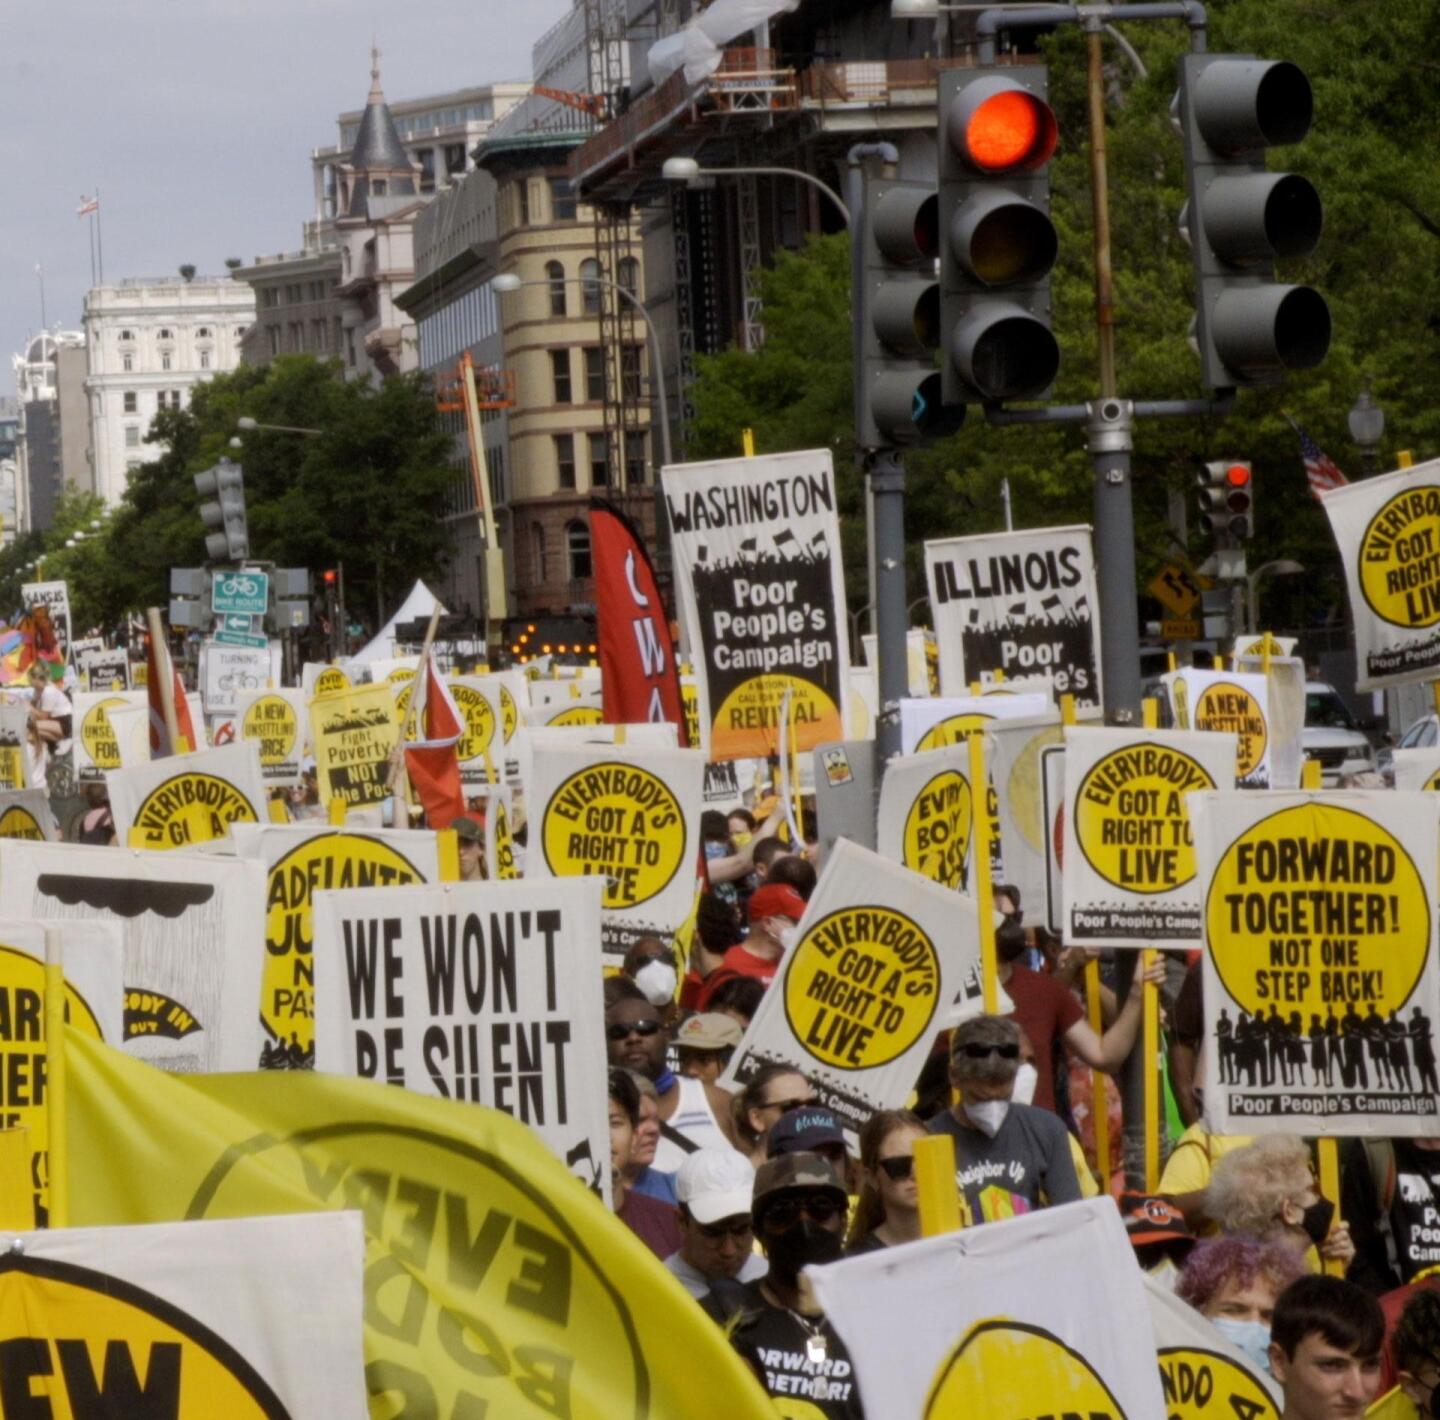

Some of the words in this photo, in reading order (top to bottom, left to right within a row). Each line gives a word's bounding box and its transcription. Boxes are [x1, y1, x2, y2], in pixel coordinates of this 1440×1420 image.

[665, 472, 833, 534] WASHINGTON
[1367, 491, 1440, 562] EVERYBO
[1396, 528, 1433, 563] GOT
[934, 547, 1081, 603] ILLINOIS
[734, 578, 797, 607] Poor
[713, 604, 826, 639] People's
[220, 653, 258, 664] TURNING
[713, 640, 832, 671] Campaign
[1002, 640, 1064, 667] Poor
[1370, 655, 1401, 669] Poor
[255, 704, 263, 720] A
[265, 703, 286, 720] NEW
[1205, 695, 1215, 715] A
[1219, 695, 1248, 715] NEW
[246, 722, 294, 737] UNSETTLING
[341, 729, 371, 745] Fight
[329, 739, 391, 763] Poverty
[347, 762, 378, 783] NOT
[142, 780, 247, 842] EVERYBODY'S
[555, 768, 676, 830] EVERYBODY'S
[1118, 791, 1160, 816] GOT
[1166, 791, 1181, 816] A
[211, 812, 224, 835] A
[586, 808, 624, 834] GOT
[631, 810, 645, 835] A
[1102, 818, 1169, 847] RIGHT
[568, 834, 629, 862] RIGHT
[634, 840, 659, 866] TO
[1237, 838, 1396, 885] FORWARD
[1119, 851, 1177, 884] LIVE
[1074, 912, 1107, 930] Poor
[1110, 912, 1162, 930] People's
[1224, 890, 1400, 935] TOGETHER!
[343, 918, 404, 1020] WE
[420, 910, 561, 1015] WON'T
[811, 912, 933, 998] EVERYBODY'S
[1269, 939, 1312, 967] NOT
[1320, 939, 1358, 967] ONE
[838, 948, 886, 988] GOT
[880, 970, 903, 999] A
[1256, 970, 1310, 1002] STEP
[1320, 969, 1383, 1000] BACK!
[806, 970, 875, 1020] RIGHT
[874, 1000, 904, 1034] TO
[806, 1008, 875, 1065] LIVE
[1231, 1094, 1274, 1114] Poor
[1280, 1093, 1351, 1117] People's
[1356, 1094, 1436, 1116] Campaign
[1009, 1160, 1025, 1184] Up
